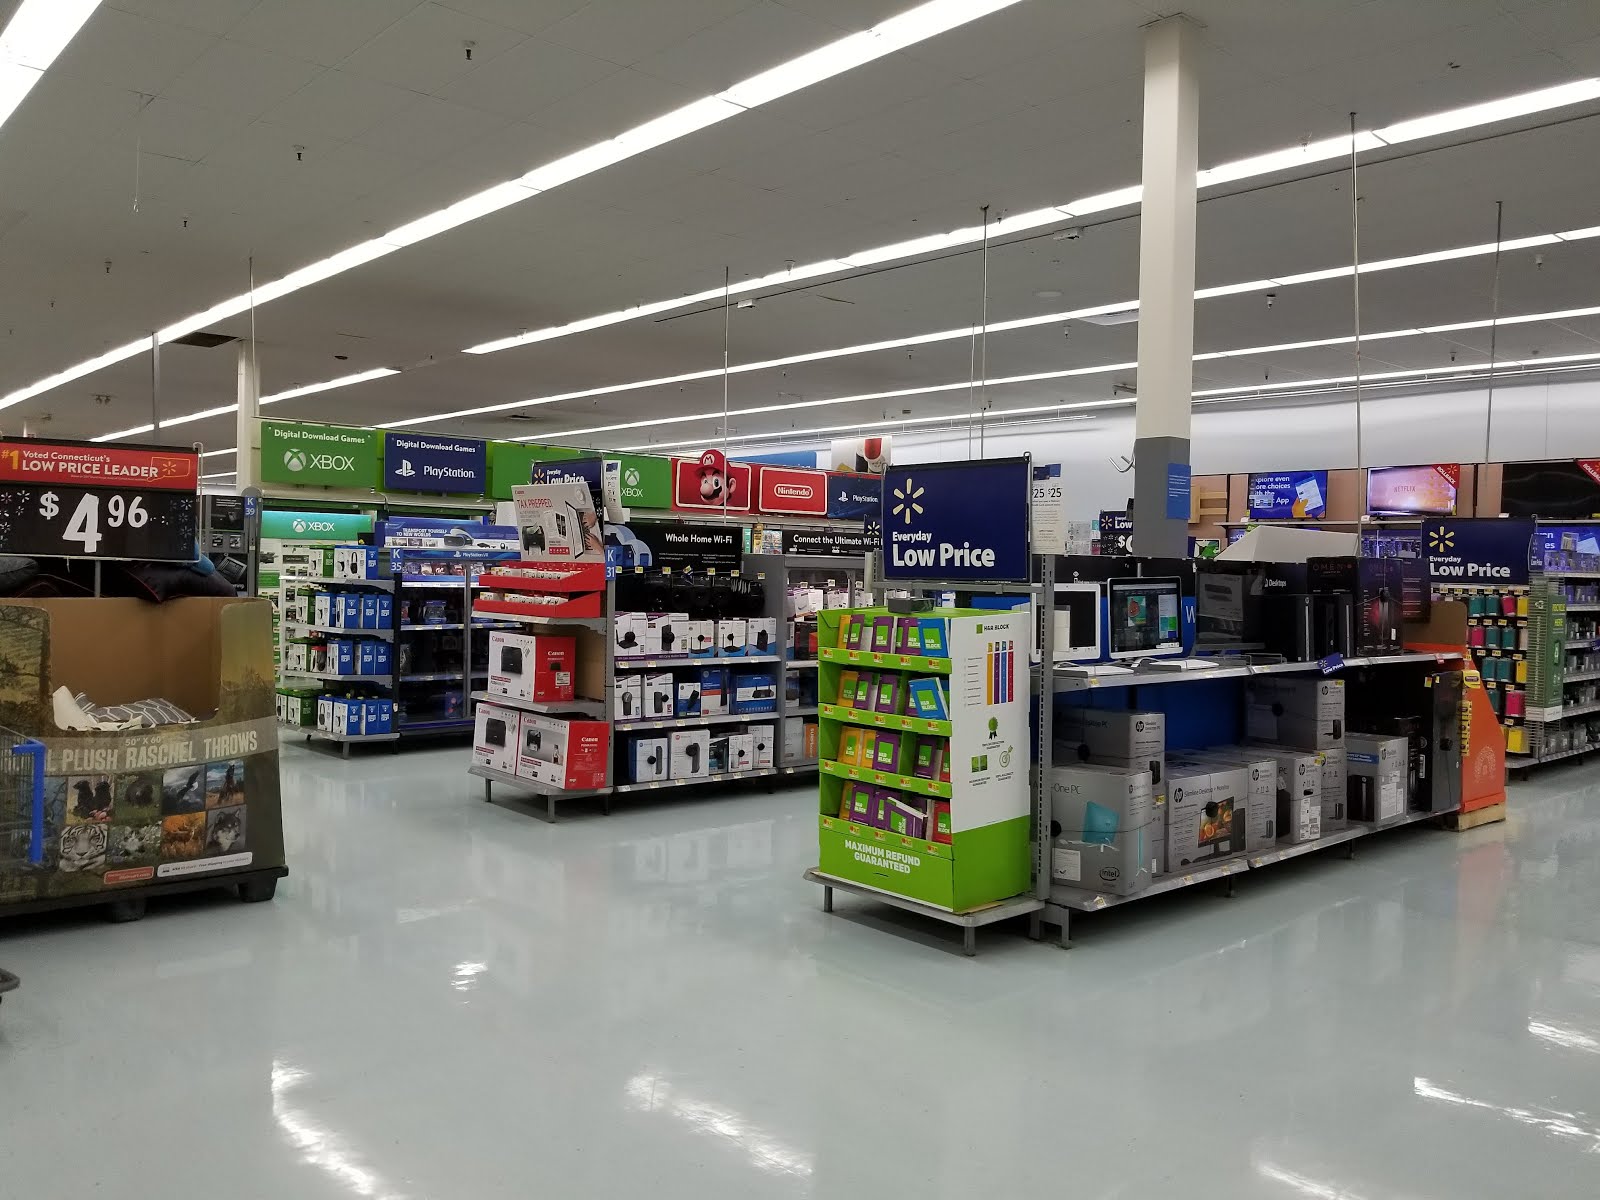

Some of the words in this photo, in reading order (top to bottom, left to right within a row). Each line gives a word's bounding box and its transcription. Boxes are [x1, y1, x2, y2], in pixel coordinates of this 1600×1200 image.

[274, 429, 300, 439] Digital
[302, 432, 338, 442] Download
[340, 434, 365, 444] Games
[396, 440, 418, 450] Digital
[420, 442, 452, 452] Download
[454, 445, 476, 453] Games
[23, 450, 49, 459] Voted
[50, 452, 110, 463] Connecticut's
[310, 453, 355, 471] XBOX
[22, 459, 55, 472] LOW
[58, 461, 100, 475] PRICE
[104, 464, 158, 478] LEADER
[423, 465, 476, 479] PlayStation
[1436, 465, 1456, 485] ROLLBACK
[620, 487, 643, 497] XBOX
[777, 487, 811, 496] Nintendo
[1393, 485, 1416, 493] NETFLIX
[247, 497, 254, 505] K
[517, 499, 529, 509] TAX
[852, 494, 879, 503] PlayStation
[1275, 497, 1290, 505] App
[245, 507, 255, 516] 39
[307, 521, 335, 532] XBOX
[1115, 520, 1132, 529] Low
[665, 533, 689, 543] Whole
[690, 534, 712, 543] Home
[713, 535, 733, 544] Wi-Fi
[793, 534, 821, 543] Connect
[822, 536, 834, 544] the
[834, 536, 862, 545] Ultimate
[892, 531, 932, 544] Everyday
[393, 549, 400, 558] K
[607, 550, 614, 562] K
[892, 545, 936, 567] Low
[939, 542, 996, 567] Price
[391, 562, 402, 571] 35
[1430, 563, 1464, 577] Low
[1467, 563, 1511, 577] Price
[606, 567, 615, 578] 31
[1269, 579, 1287, 587] Desktops
[62, 748, 118, 771] PLUSH
[125, 740, 197, 769] RASCHEL
[203, 731, 258, 759] THROWS
[1071, 785, 1082, 795] PC
[844, 839, 885, 857] MAXIMUM
[885, 850, 921, 866] REFUND
[854, 853, 911, 874] GUARANTEED
[1102, 868, 1117, 878] intel
